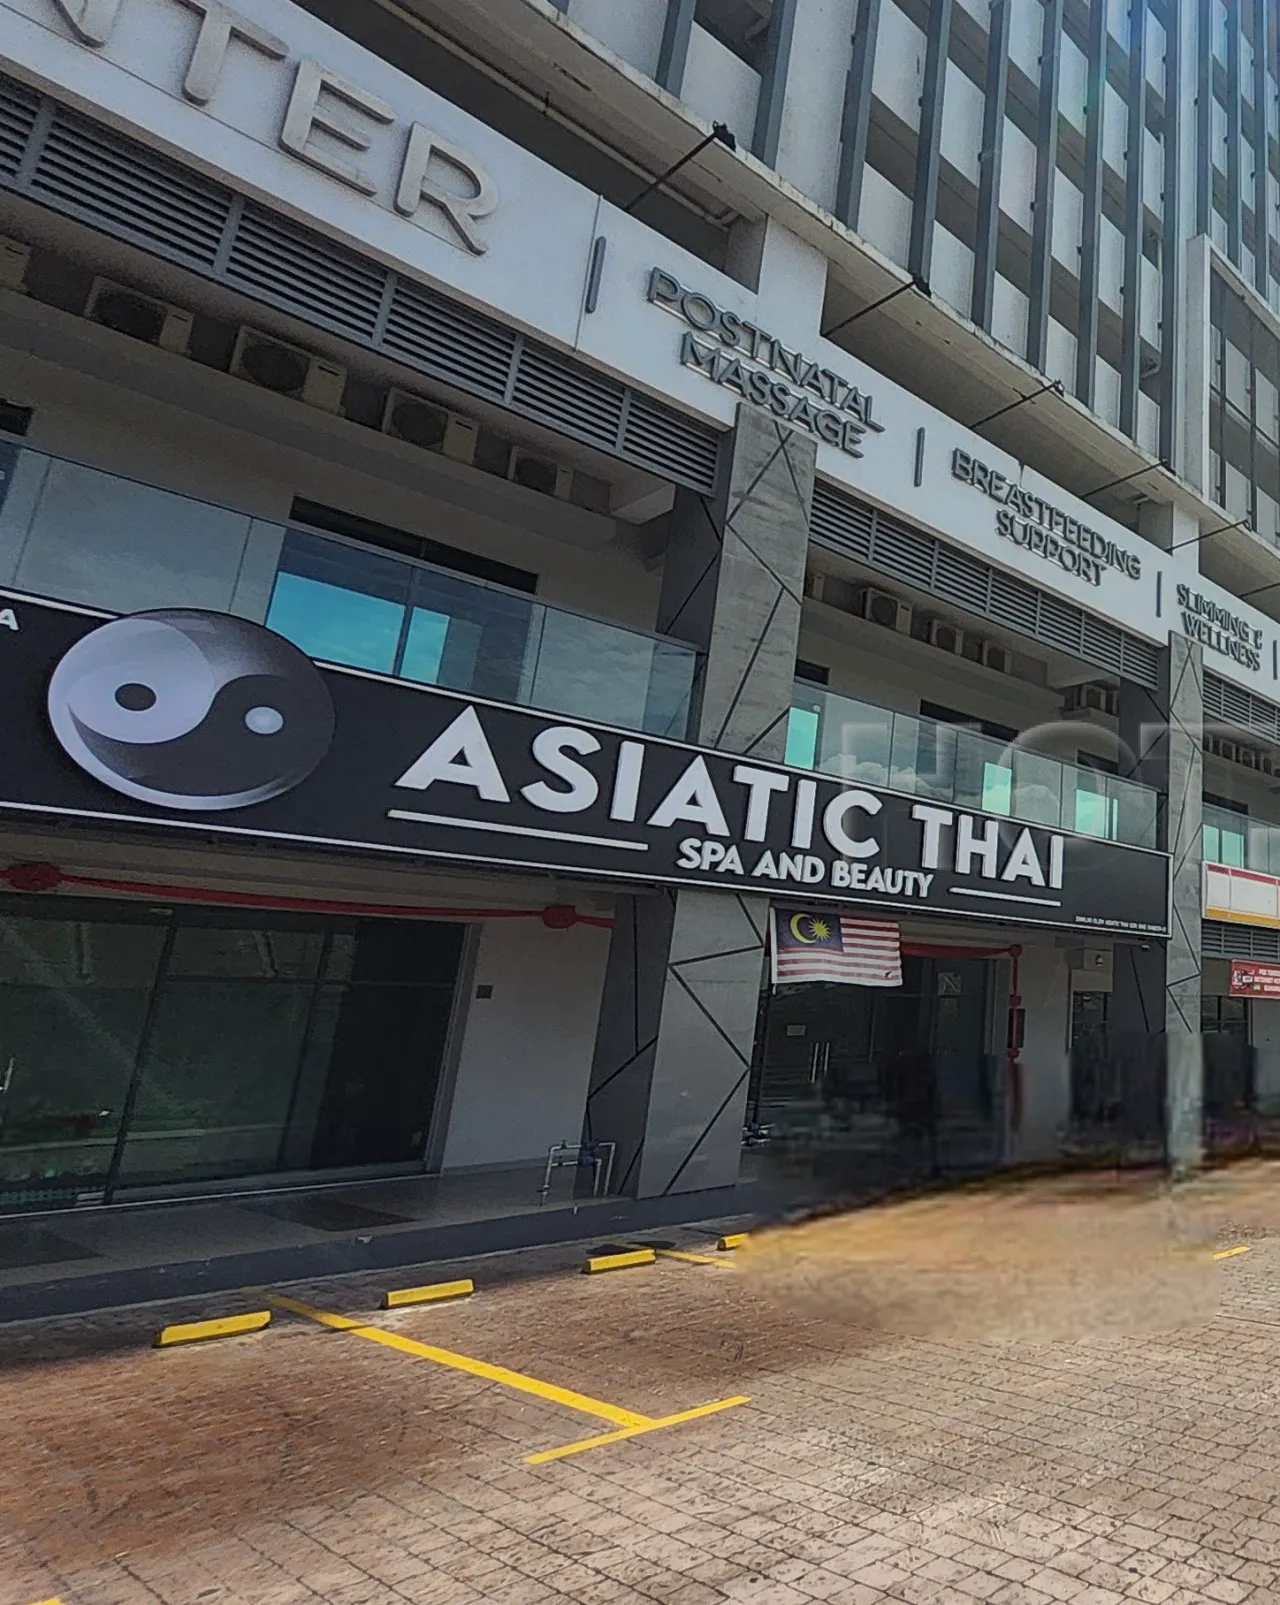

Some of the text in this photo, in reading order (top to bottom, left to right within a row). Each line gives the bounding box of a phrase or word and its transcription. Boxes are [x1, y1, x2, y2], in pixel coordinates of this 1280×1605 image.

[646, 266, 886, 434] POSTNATAL
[679, 331, 866, 459] MASSAGE
[951, 446, 1142, 581] BREASTFEEDING
[995, 508, 1109, 587] SUPPORT
[1177, 583, 1250, 643] SLIMMING
[1181, 611, 1261, 672] WELLNESS
[394, 704, 1065, 891] ASIATIC THAI
[676, 838, 934, 899] SPA AND BEAUTY
